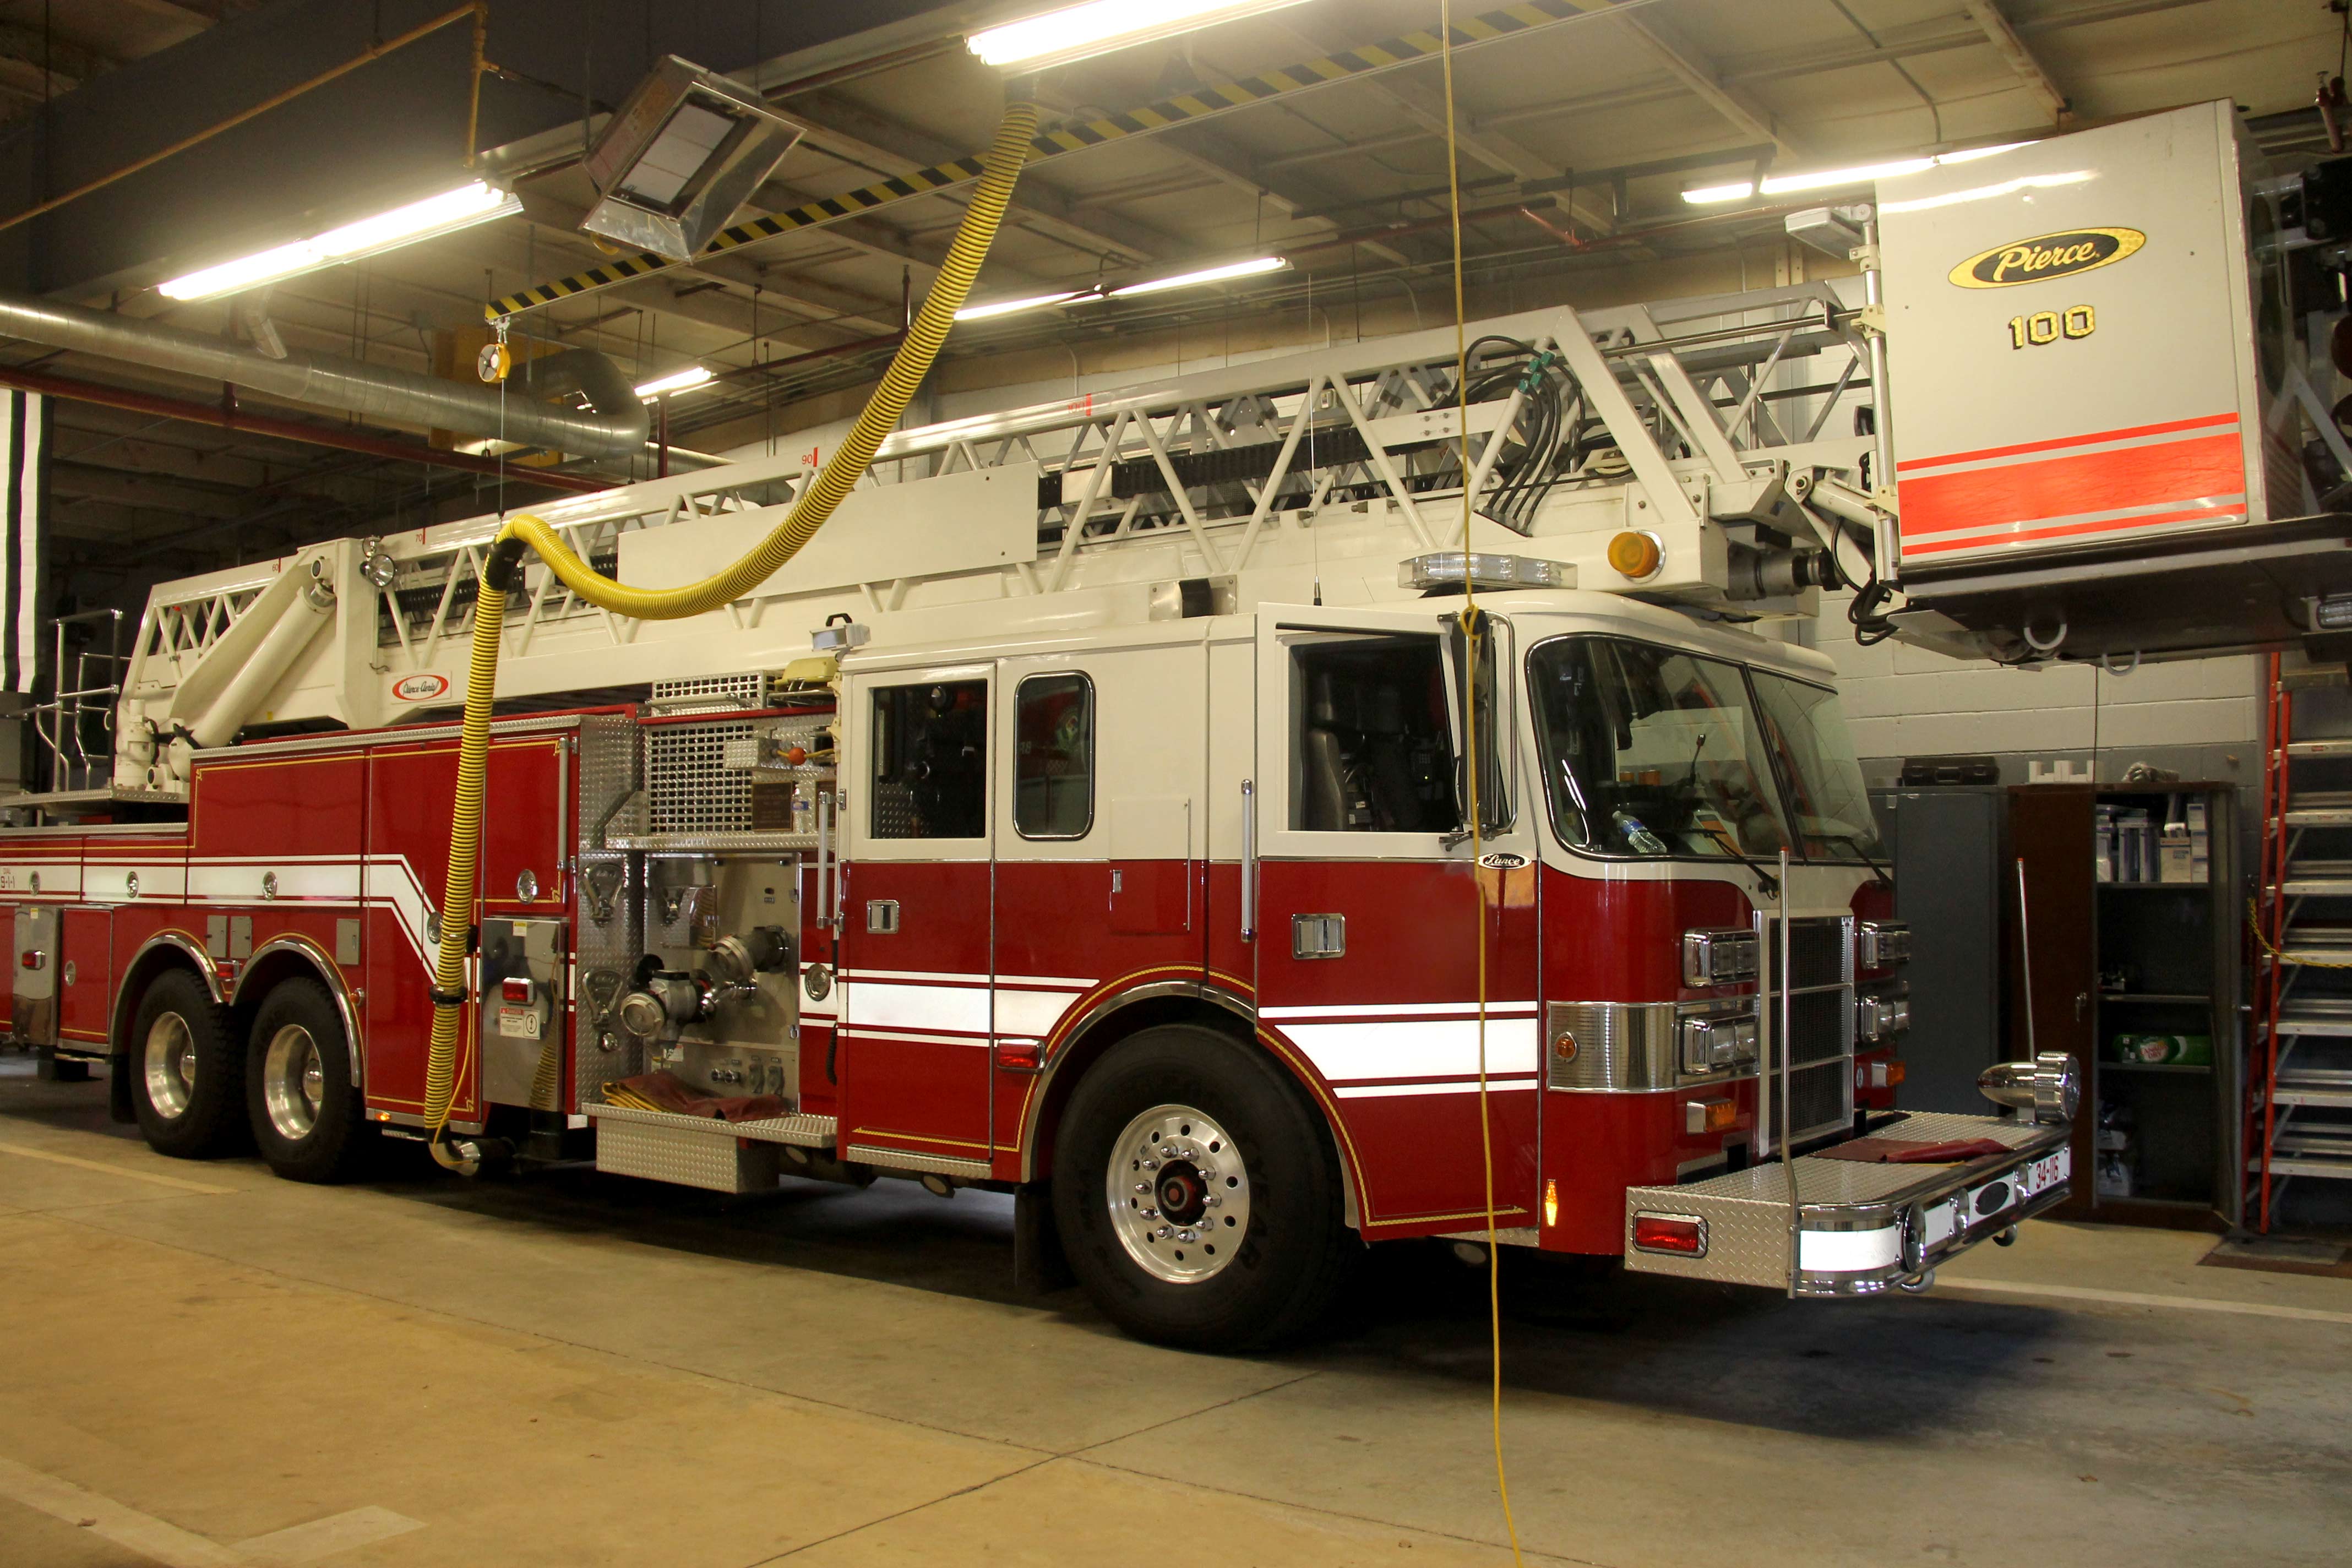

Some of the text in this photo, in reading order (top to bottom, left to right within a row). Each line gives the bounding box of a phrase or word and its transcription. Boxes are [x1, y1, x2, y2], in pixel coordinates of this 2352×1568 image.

[1992, 241, 2096, 282] Pierce
[2008, 304, 2095, 350] 100
[802, 454, 813, 465] 90
[415, 533, 423, 542] 70
[273, 563, 278, 571] 60
[1485, 854, 1521, 866] Lance
[2036, 1155, 2059, 1189] 34-116
